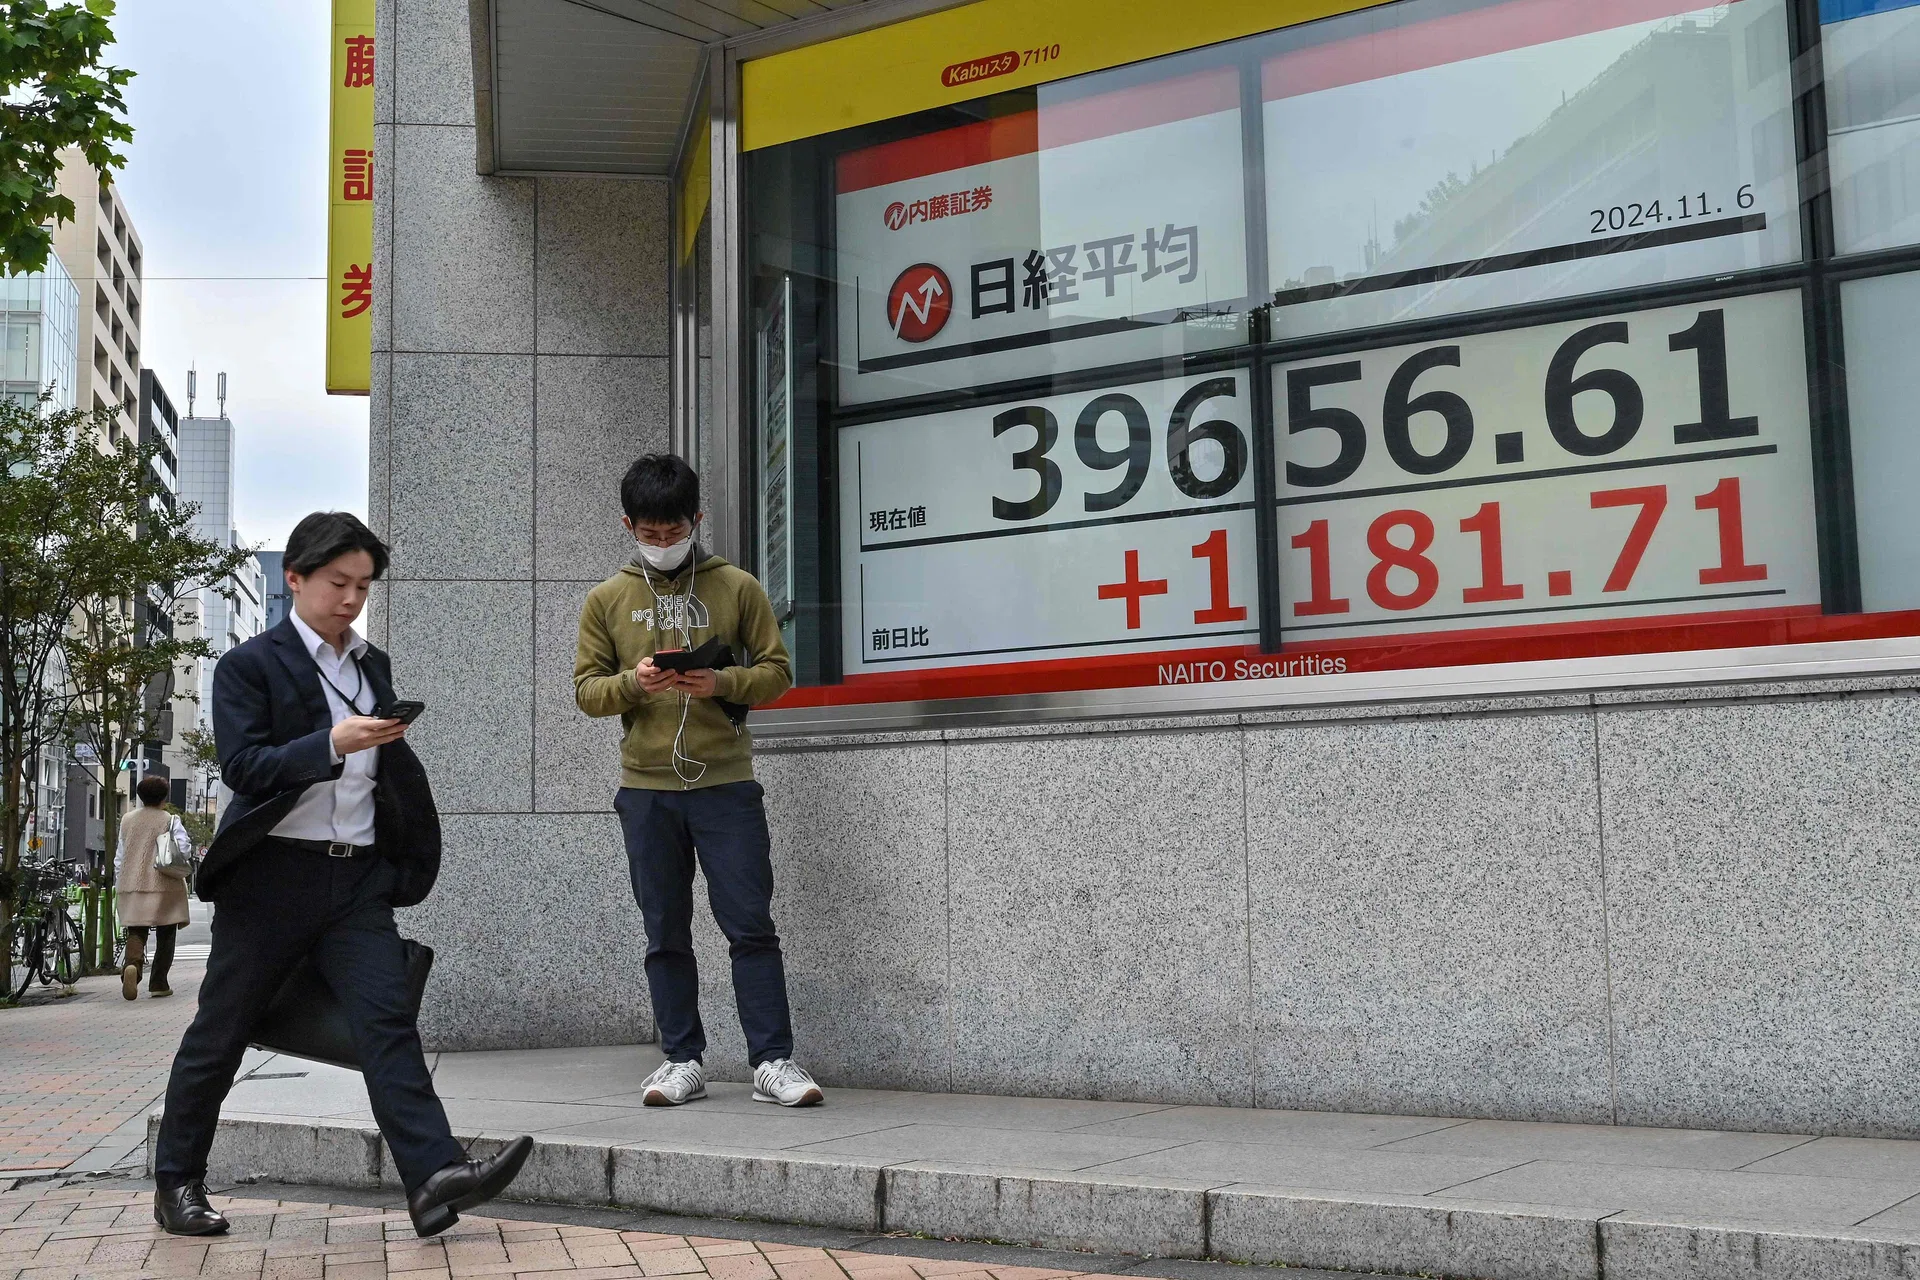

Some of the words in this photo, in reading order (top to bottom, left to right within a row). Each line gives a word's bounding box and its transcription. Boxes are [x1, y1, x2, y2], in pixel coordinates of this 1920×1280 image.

[949, 55, 1012, 84] Kabuスタ
[1023, 43, 1060, 66] 7110
[909, 185, 993, 225] 内藤証券
[971, 223, 1199, 320] 日経平均
[869, 505, 927, 532] 現在値
[656, 594, 684, 607] THE
[872, 625, 929, 651] 前日比
[1158, 661, 1226, 685] NAITO
[1234, 653, 1347, 680] Securities
